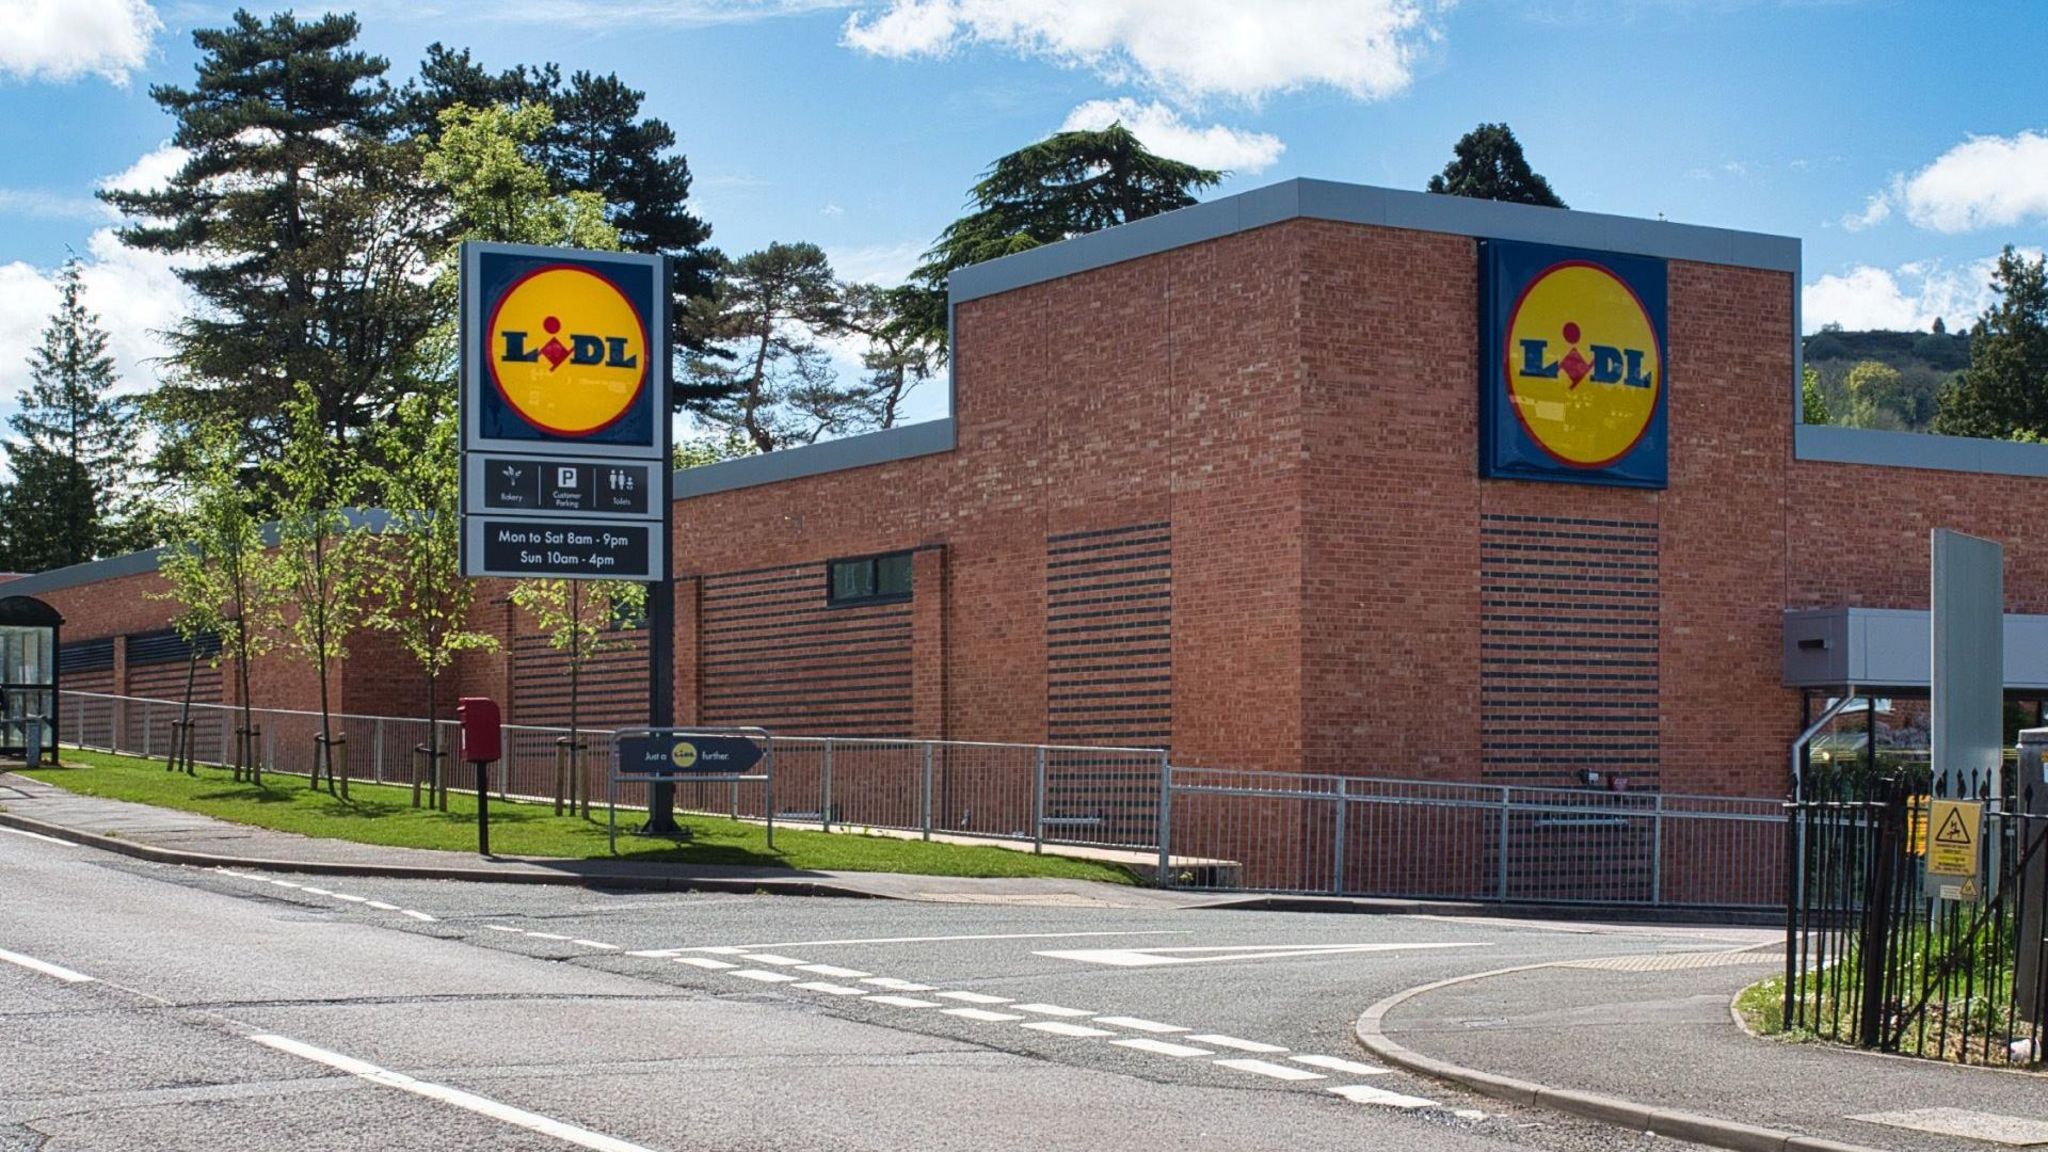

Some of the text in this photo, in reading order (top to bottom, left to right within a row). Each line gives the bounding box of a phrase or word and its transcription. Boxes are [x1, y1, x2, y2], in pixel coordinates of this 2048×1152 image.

[562, 470, 574, 485] P
[501, 493, 523, 503] Bakery
[552, 491, 581, 499] Customer
[556, 499, 579, 508] Parking
[613, 497, 631, 506] Toilets
[499, 531, 526, 543] Mon
[529, 532, 541, 544] to
[545, 532, 564, 544] Sat
[567, 532, 593, 545] 8am
[603, 533, 629, 548] 9pm
[520, 551, 542, 563] Sun
[547, 552, 578, 565] 10am
[589, 553, 614, 568] 4pm
[644, 751, 659, 761] Just
